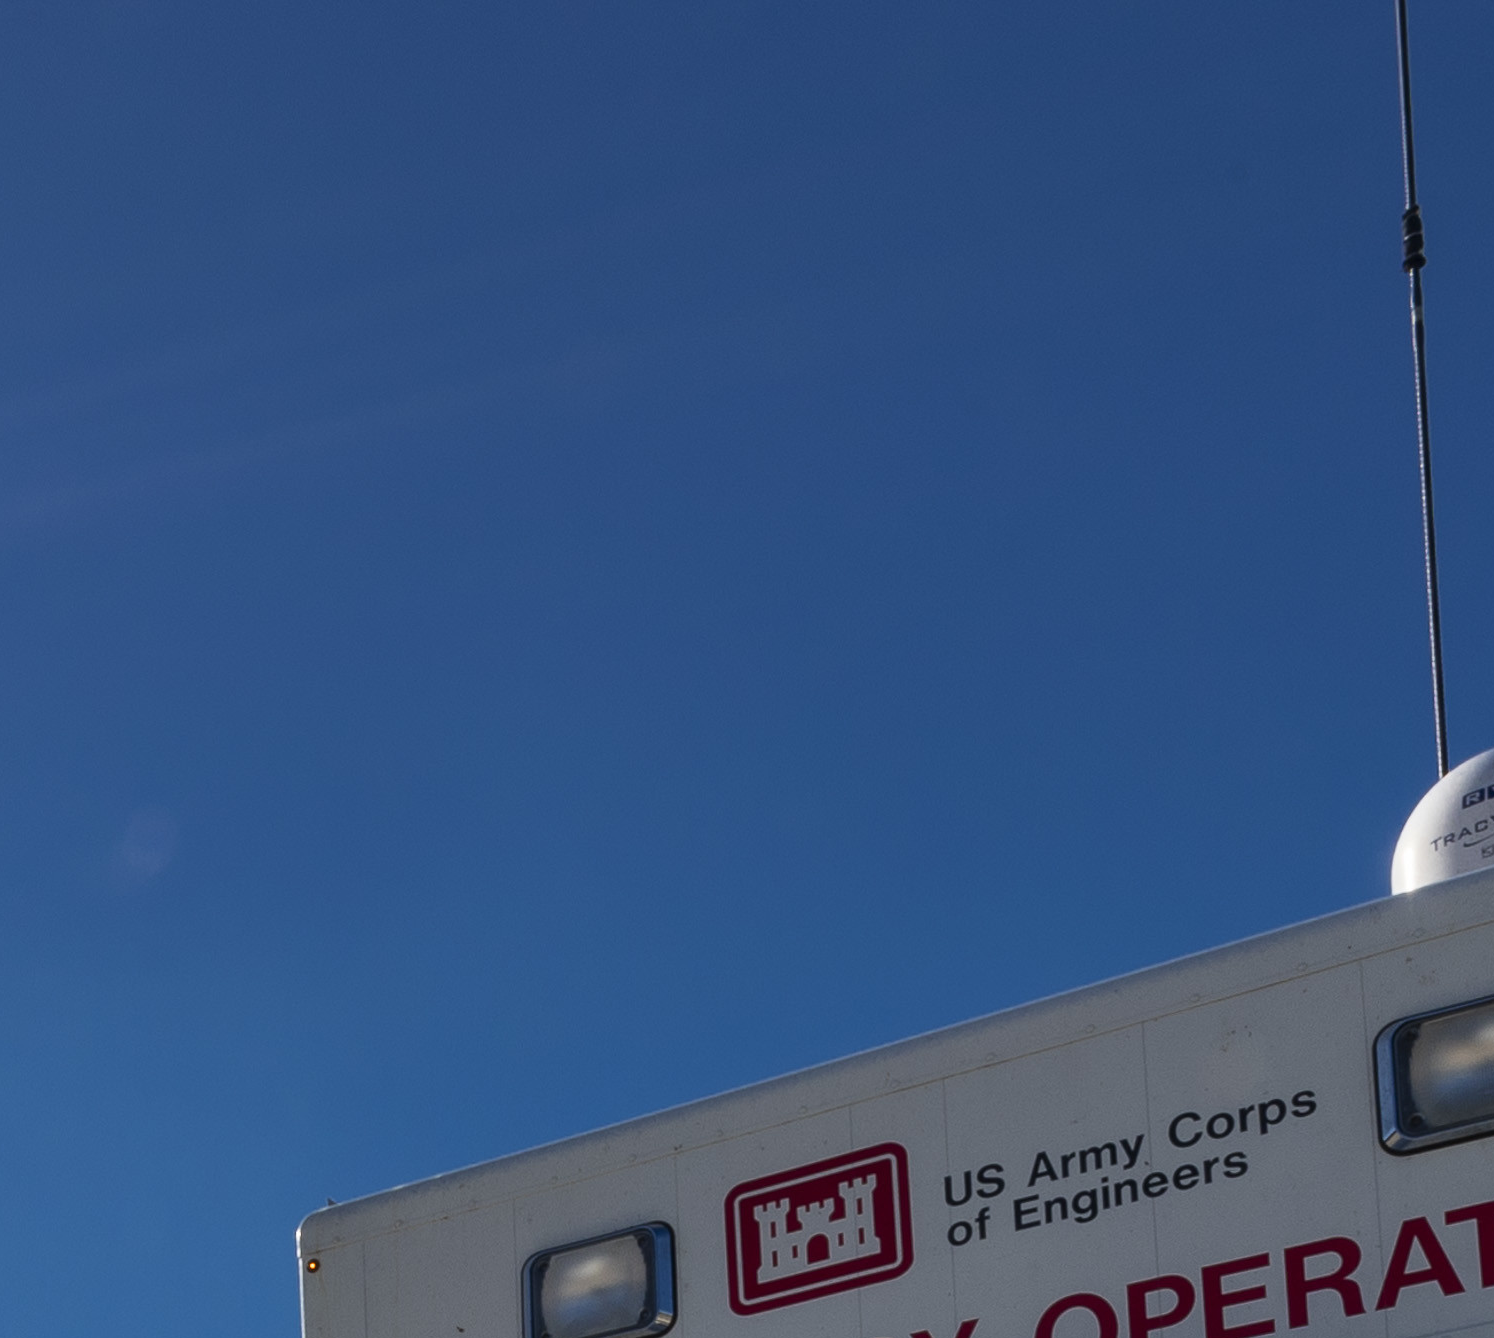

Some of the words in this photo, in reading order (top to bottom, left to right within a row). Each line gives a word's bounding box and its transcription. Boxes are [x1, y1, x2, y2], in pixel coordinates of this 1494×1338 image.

[942, 1163, 1006, 1209] US
[1026, 1132, 1145, 1189] Army
[1168, 1090, 1318, 1150] Corps
[947, 1206, 992, 1248] of
[1012, 1150, 1250, 1233] Engineers
